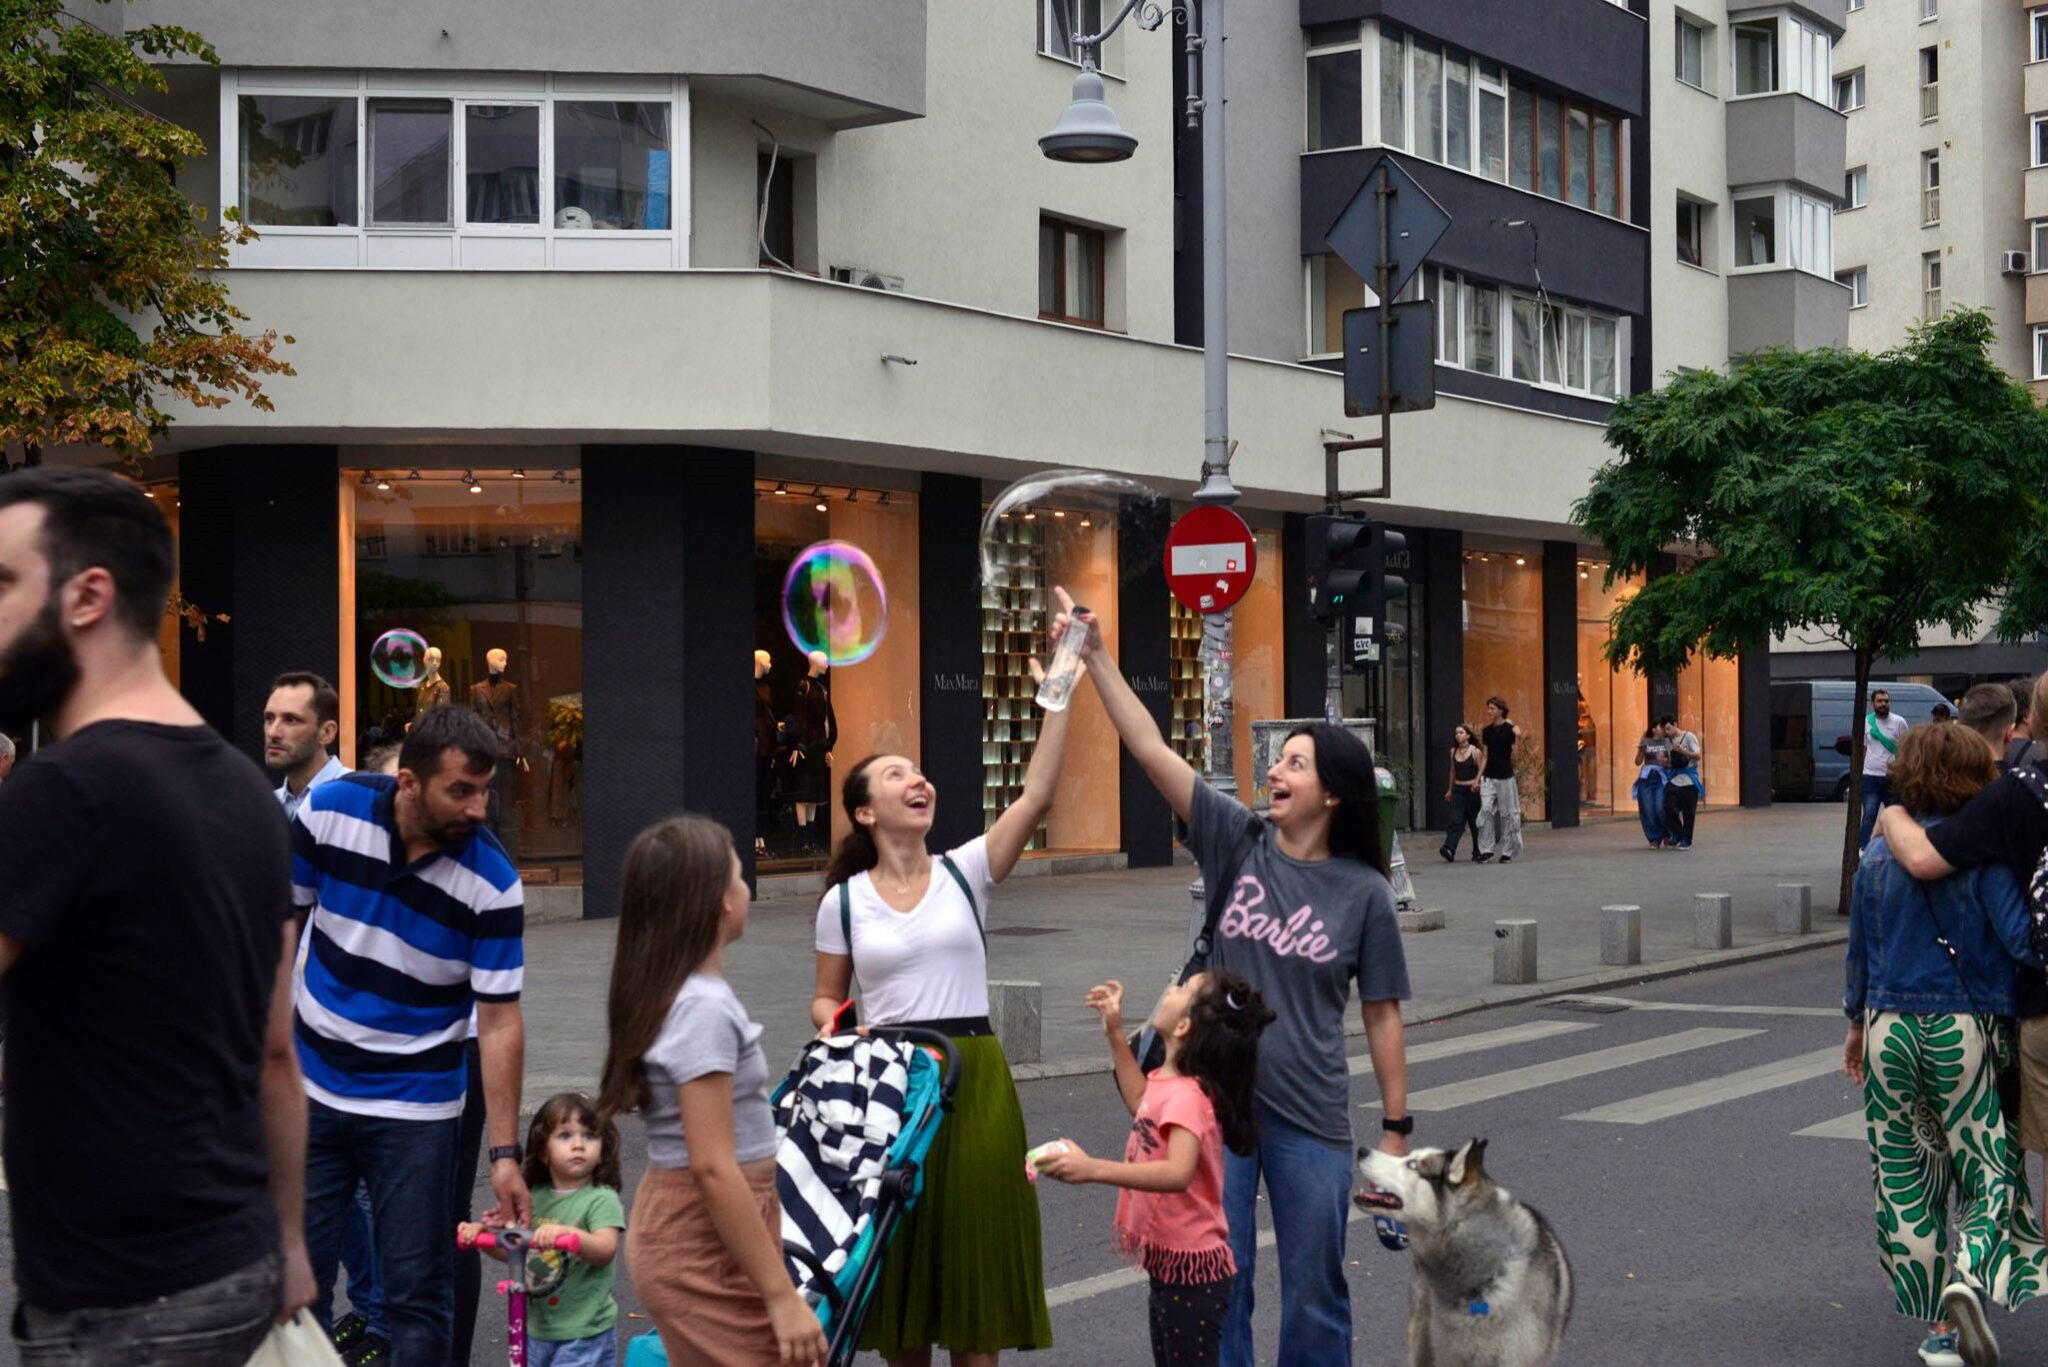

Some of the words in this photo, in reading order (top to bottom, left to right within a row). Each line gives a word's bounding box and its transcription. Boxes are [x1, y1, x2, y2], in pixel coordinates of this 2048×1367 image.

[934, 673, 979, 691] MaxMara
[1131, 675, 1168, 691] MaxMara
[1219, 875, 1339, 963] Barbie
